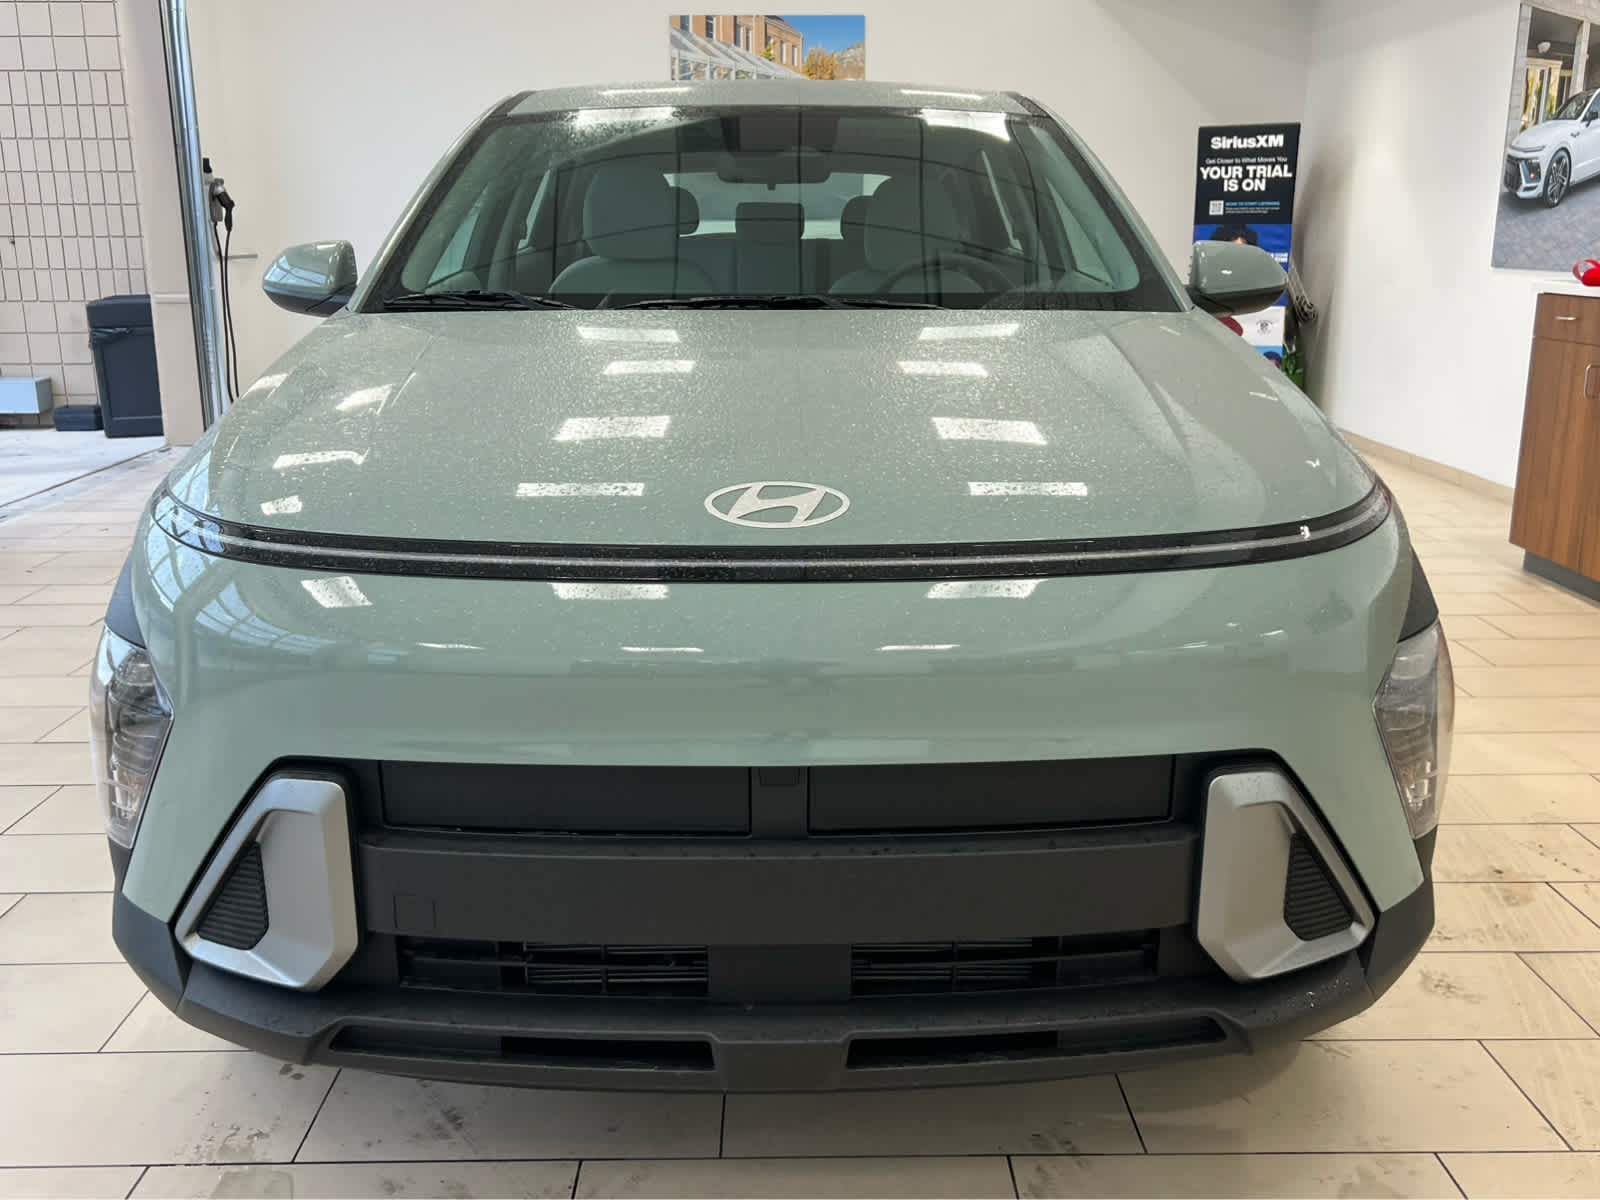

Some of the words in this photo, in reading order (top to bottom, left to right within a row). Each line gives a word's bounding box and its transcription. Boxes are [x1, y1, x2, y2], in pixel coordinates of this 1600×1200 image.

[1210, 134, 1284, 149] SiriusXM
[1277, 155, 1288, 163] You
[1200, 166, 1243, 180] YOUR
[1245, 164, 1293, 178] TRIAL
[1223, 179, 1239, 192] IS
[1241, 178, 1266, 192] ON
